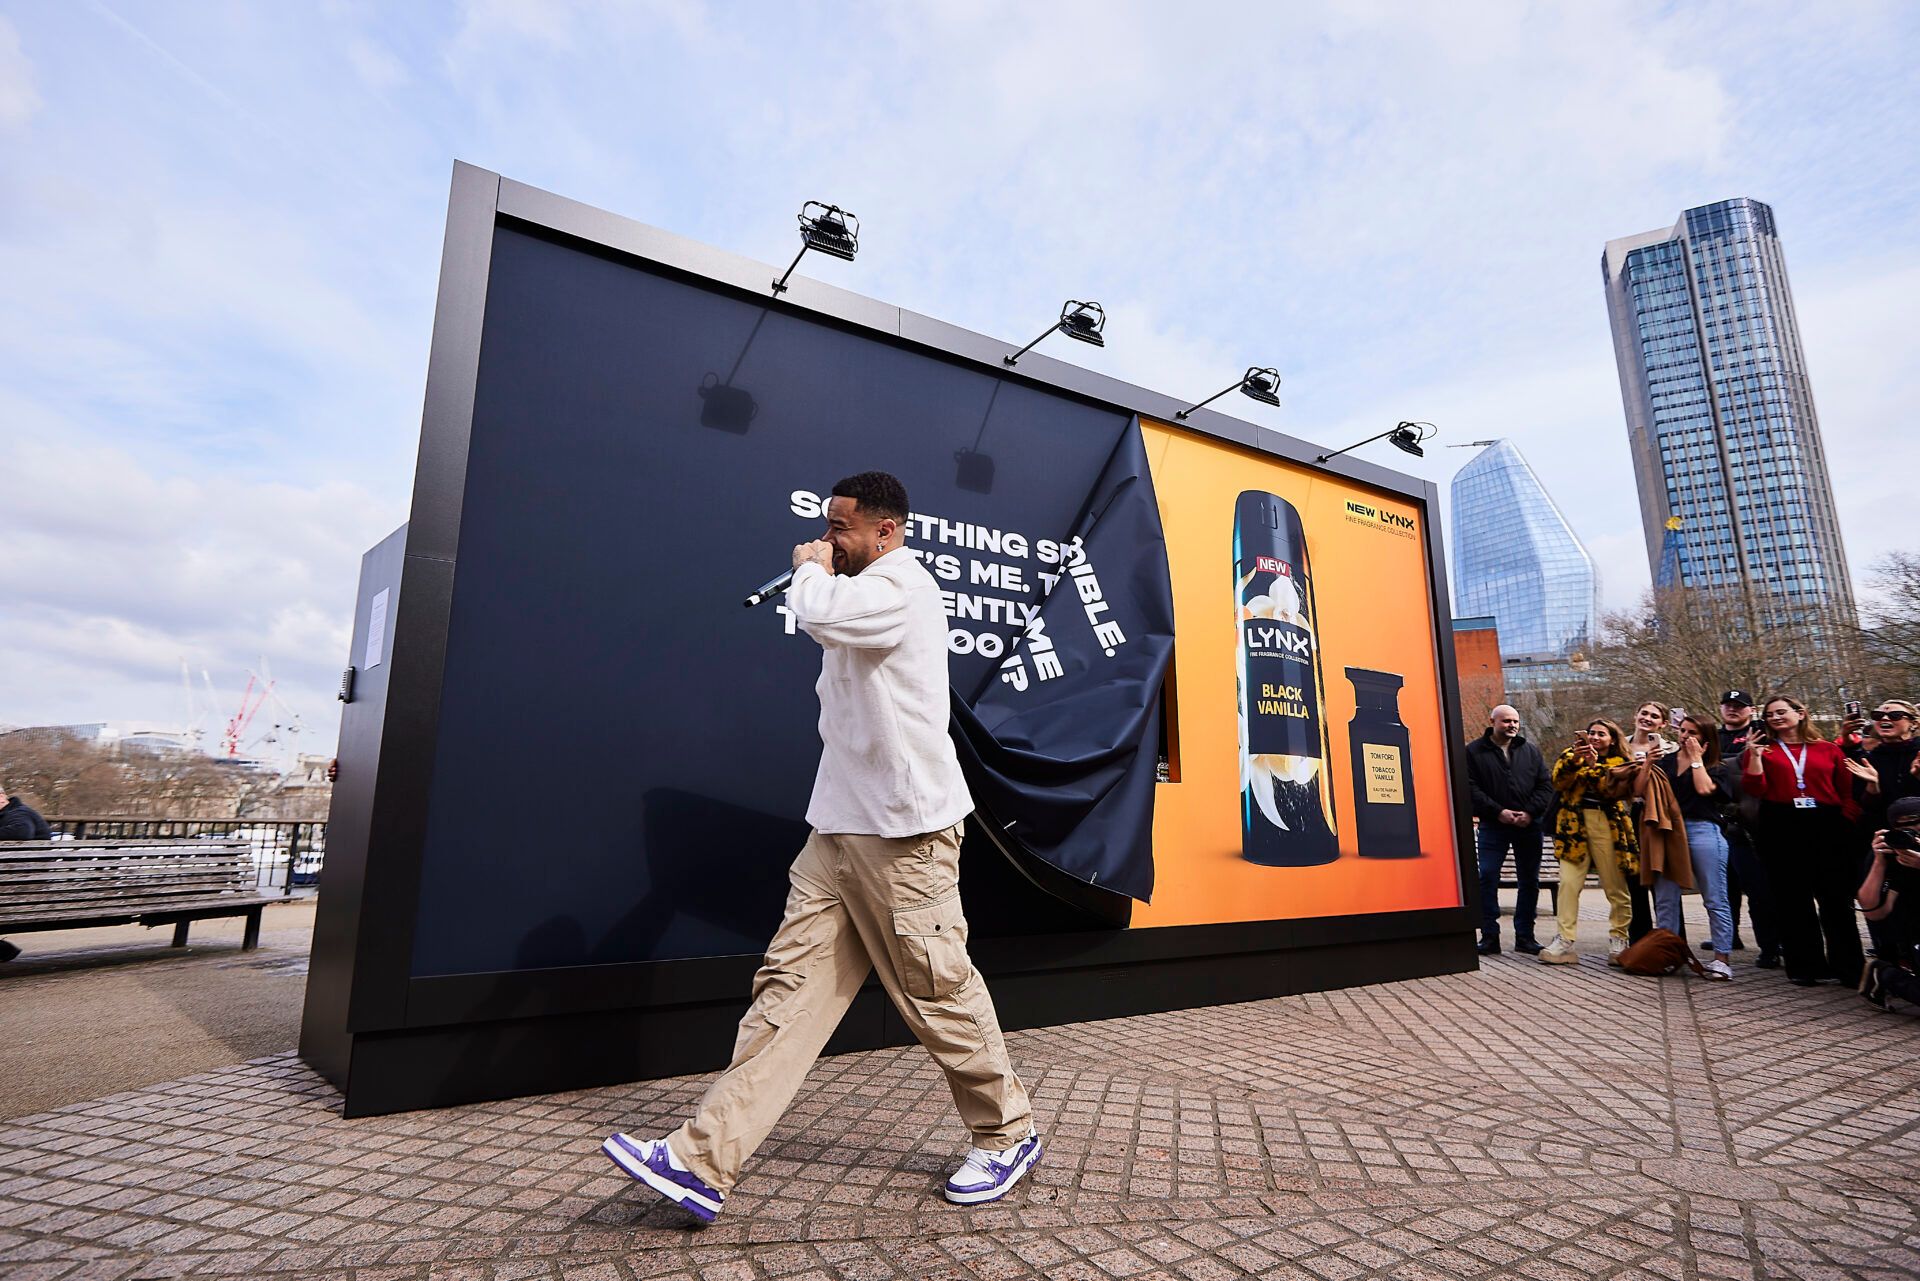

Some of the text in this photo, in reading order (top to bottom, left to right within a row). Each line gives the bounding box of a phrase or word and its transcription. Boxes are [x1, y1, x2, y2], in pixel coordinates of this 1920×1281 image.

[790, 490, 1029, 559] STHING
[1346, 501, 1415, 531] NEW LYNX
[1259, 558, 1287, 574] NEW
[970, 560, 1030, 593] ME.
[940, 590, 1042, 628] ENTLY
[1247, 627, 1310, 657] LYNX
[1262, 683, 1303, 702] BLACK
[1729, 691, 1740, 699] P
[1257, 700, 1310, 720] VANILLA
[1370, 752, 1395, 761] TOM FORD
[1371, 766, 1396, 774] TOBACCO
